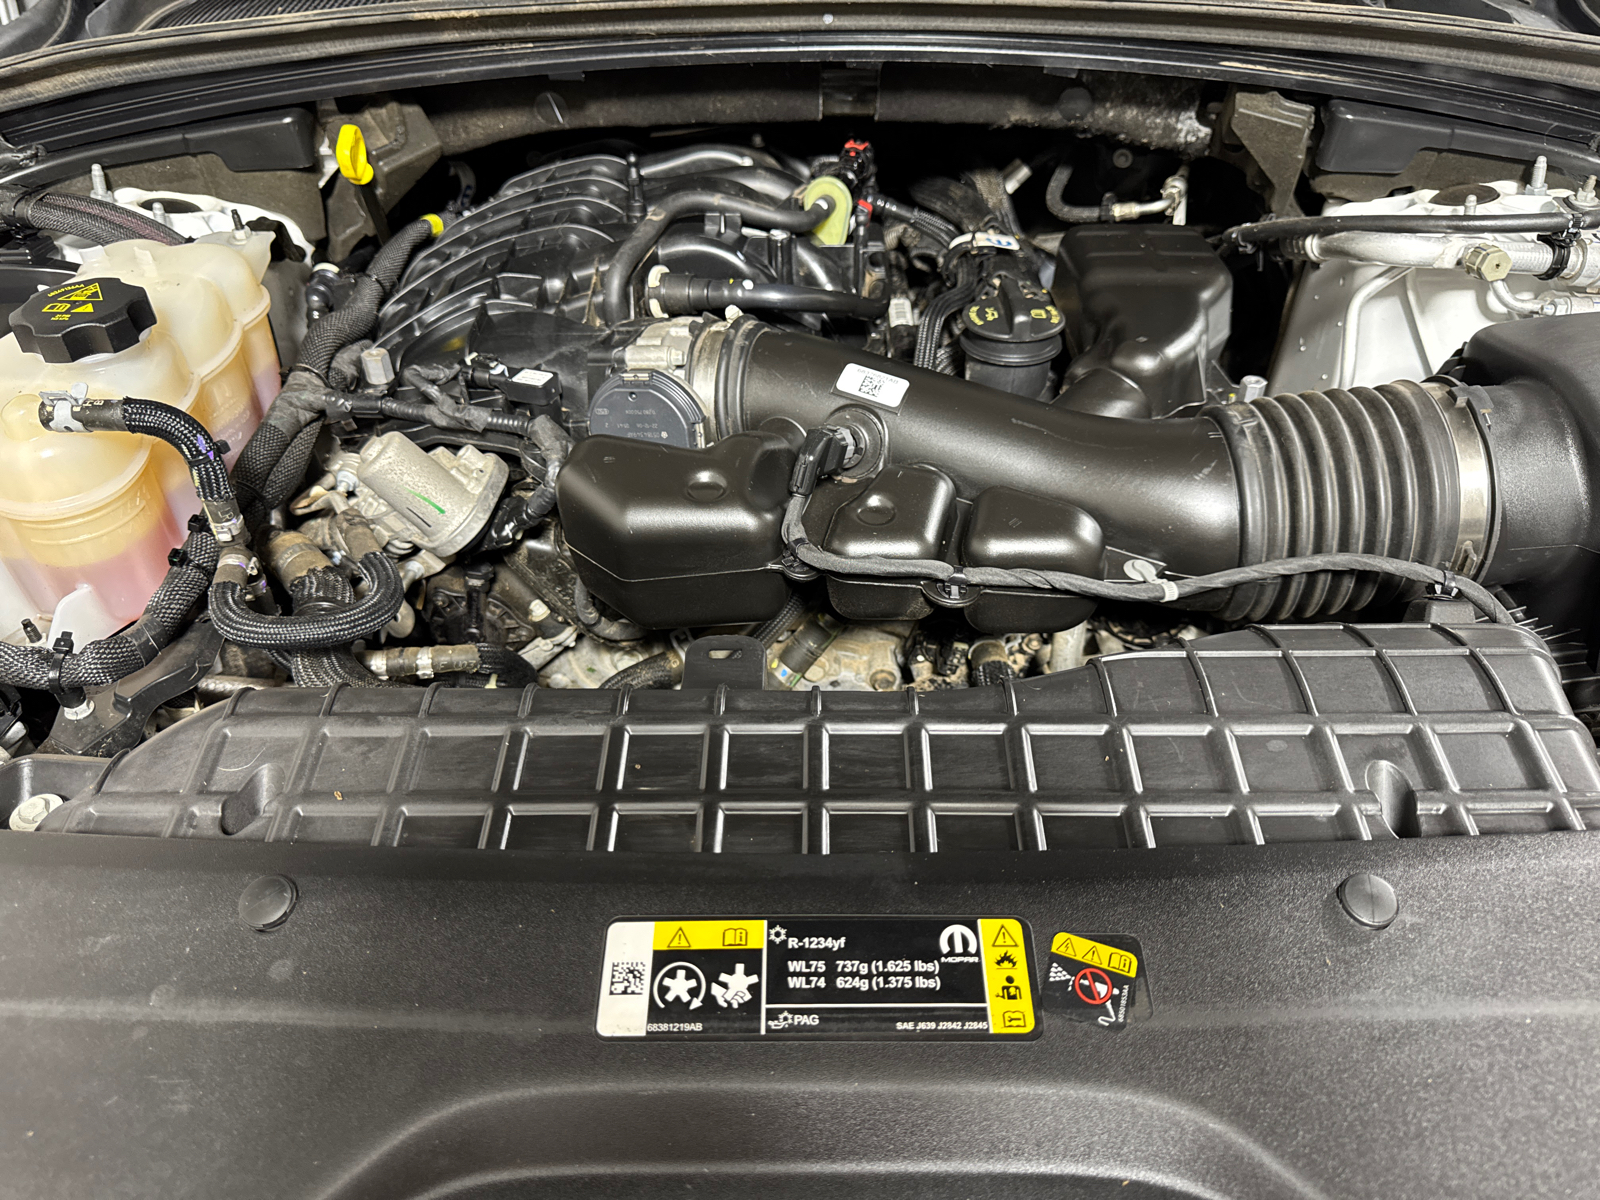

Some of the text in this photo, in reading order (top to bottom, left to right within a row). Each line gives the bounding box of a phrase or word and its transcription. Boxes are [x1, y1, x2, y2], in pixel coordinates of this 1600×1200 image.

[787, 936, 846, 951] R-1234yf
[787, 960, 940, 975] WL75 737g (1.625 lbs)
[787, 975, 941, 991] WL74 624g (1.375 lbs)
[793, 1014, 820, 1026] PAG
[895, 1021, 989, 1030] SAE J639 J2842 J2845
[646, 1022, 703, 1032] 68381219AB
